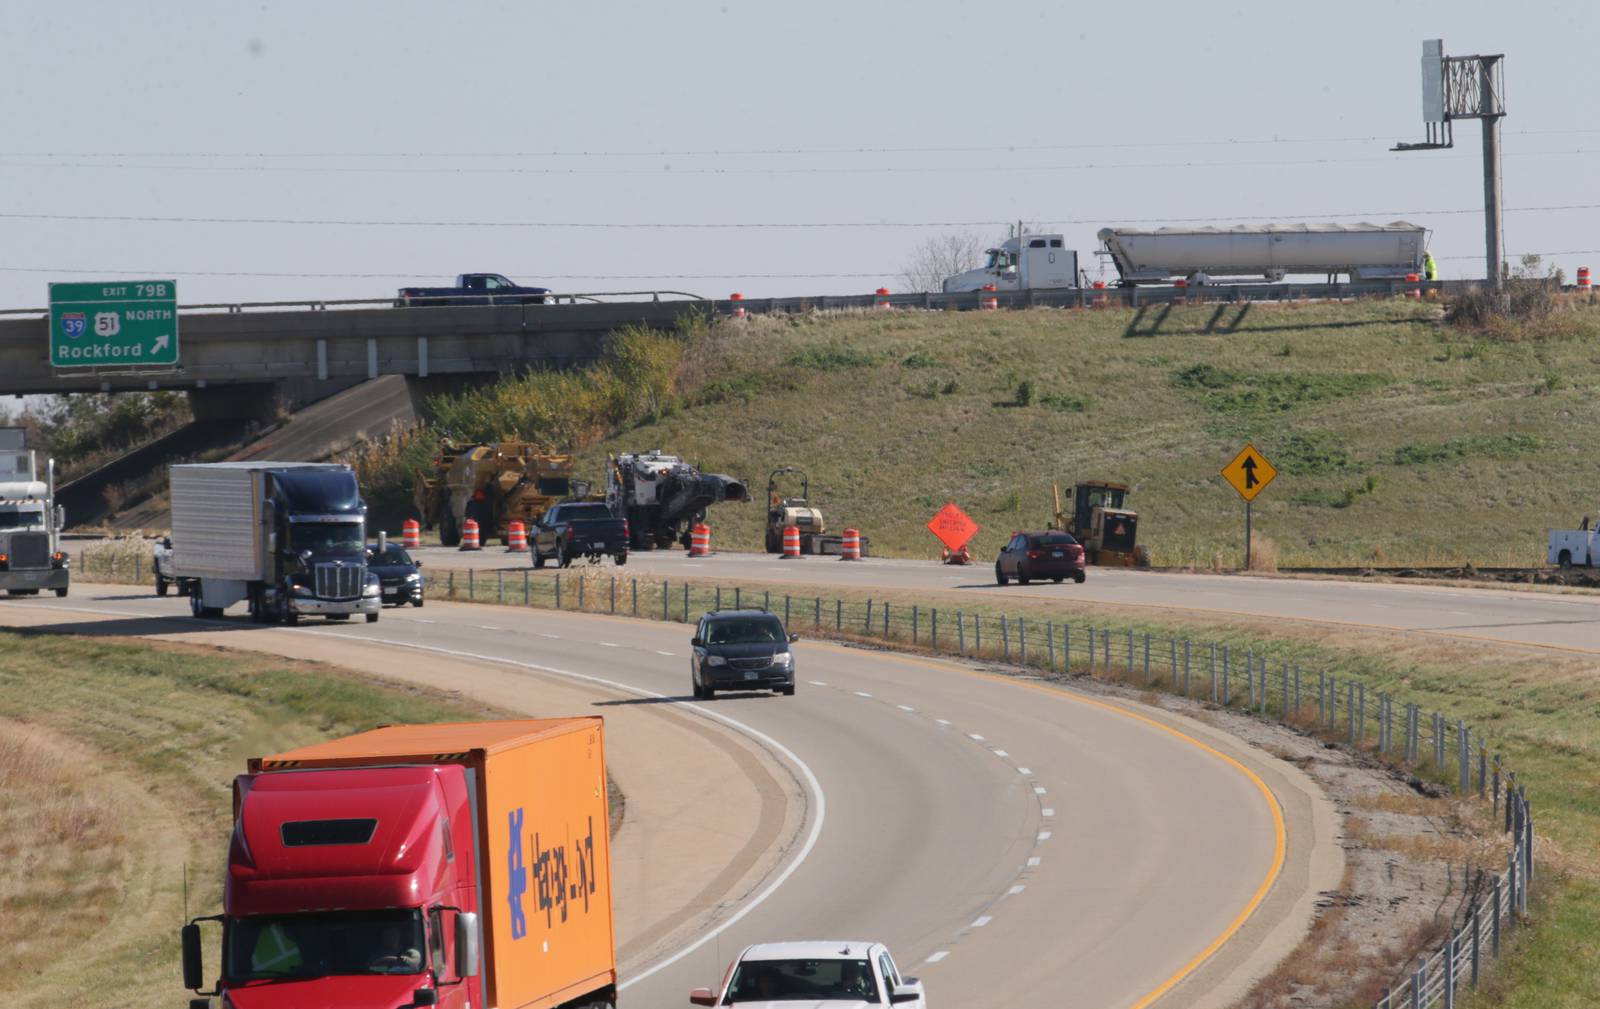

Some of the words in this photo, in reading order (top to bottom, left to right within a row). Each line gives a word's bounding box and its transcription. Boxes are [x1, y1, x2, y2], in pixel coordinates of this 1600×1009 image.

[102, 287, 127, 297] EXIT
[135, 284, 167, 297] 79B
[125, 310, 172, 321] NORTH
[65, 320, 83, 333] 39
[99, 317, 115, 331] 51
[58, 343, 142, 359] Rockford
